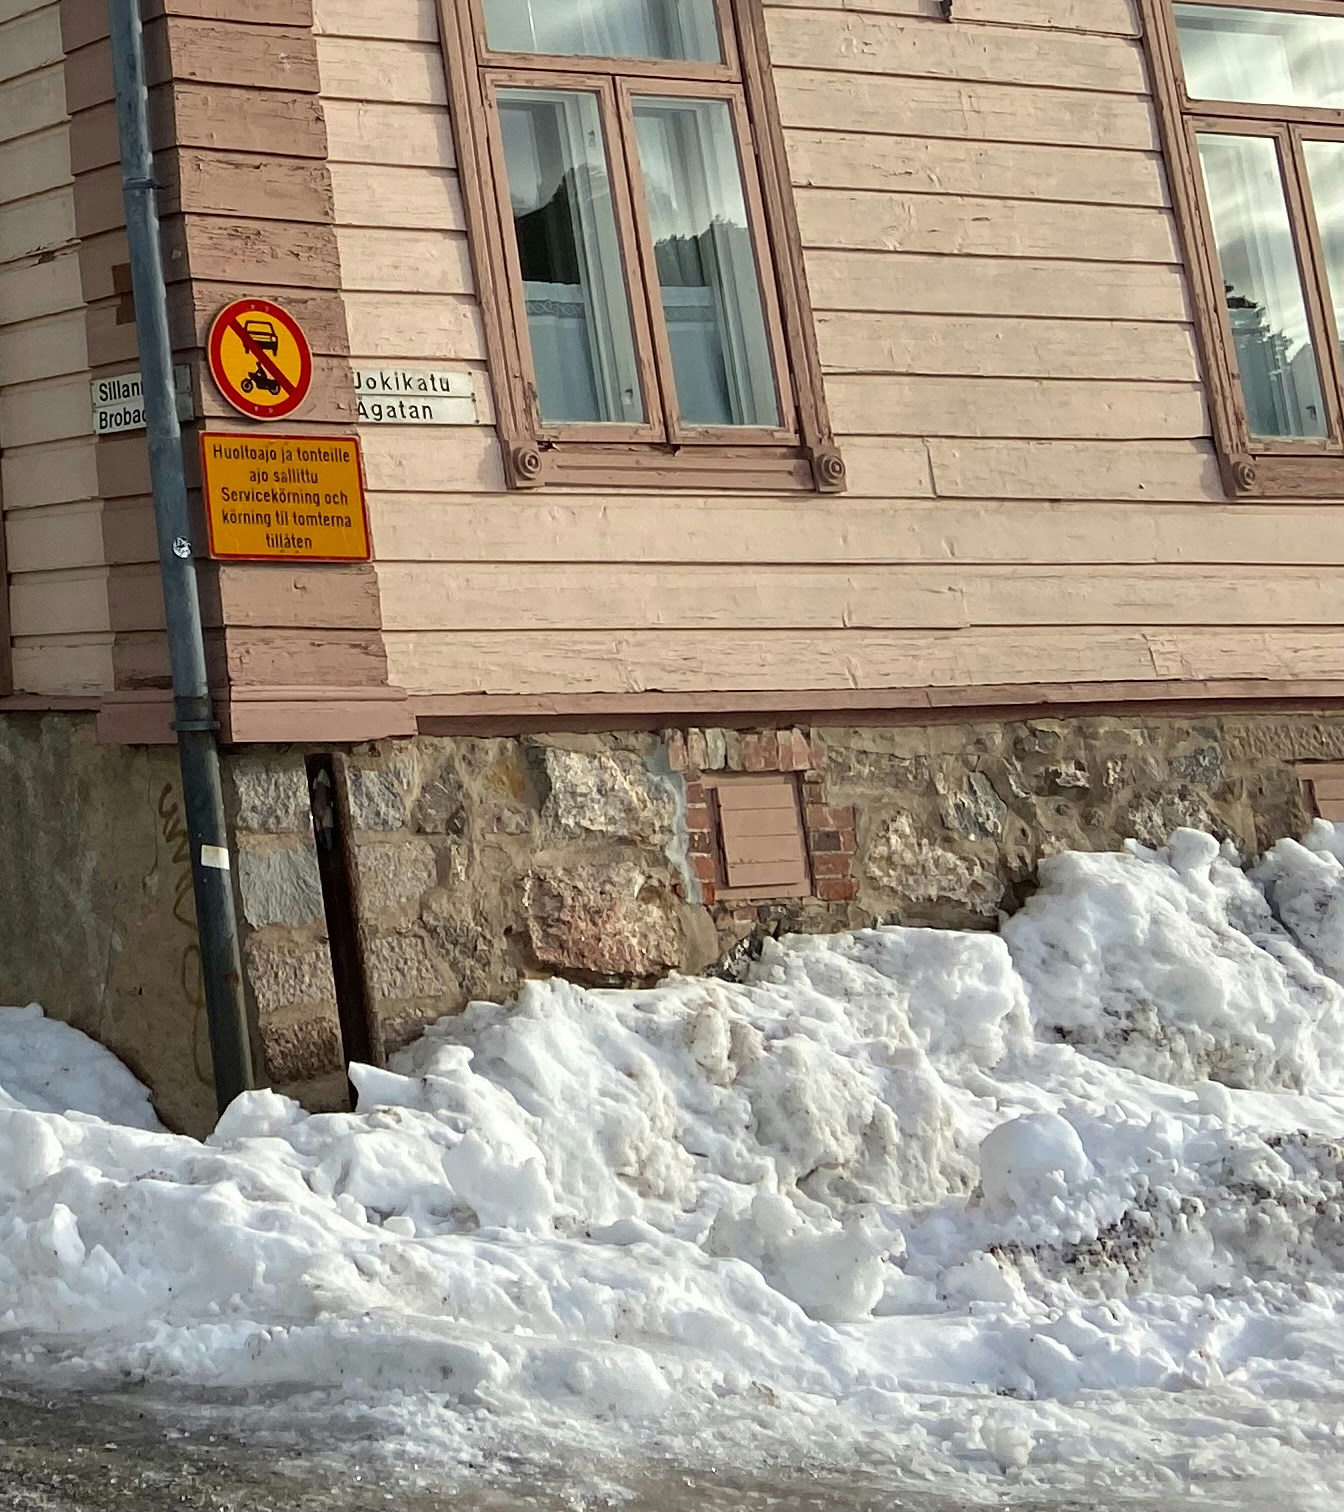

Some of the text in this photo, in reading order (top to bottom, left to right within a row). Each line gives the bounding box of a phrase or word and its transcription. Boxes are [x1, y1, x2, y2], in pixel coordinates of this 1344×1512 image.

[354, 371, 450, 392] Jokikatu
[212, 444, 350, 464] Huoltoajo ja tonteille
[249, 467, 318, 485] ajo sallittu
[221, 487, 348, 508] Servicekörning och
[222, 509, 272, 528] körning
[293, 511, 352, 528] tomterna
[265, 533, 313, 550] tillåten
